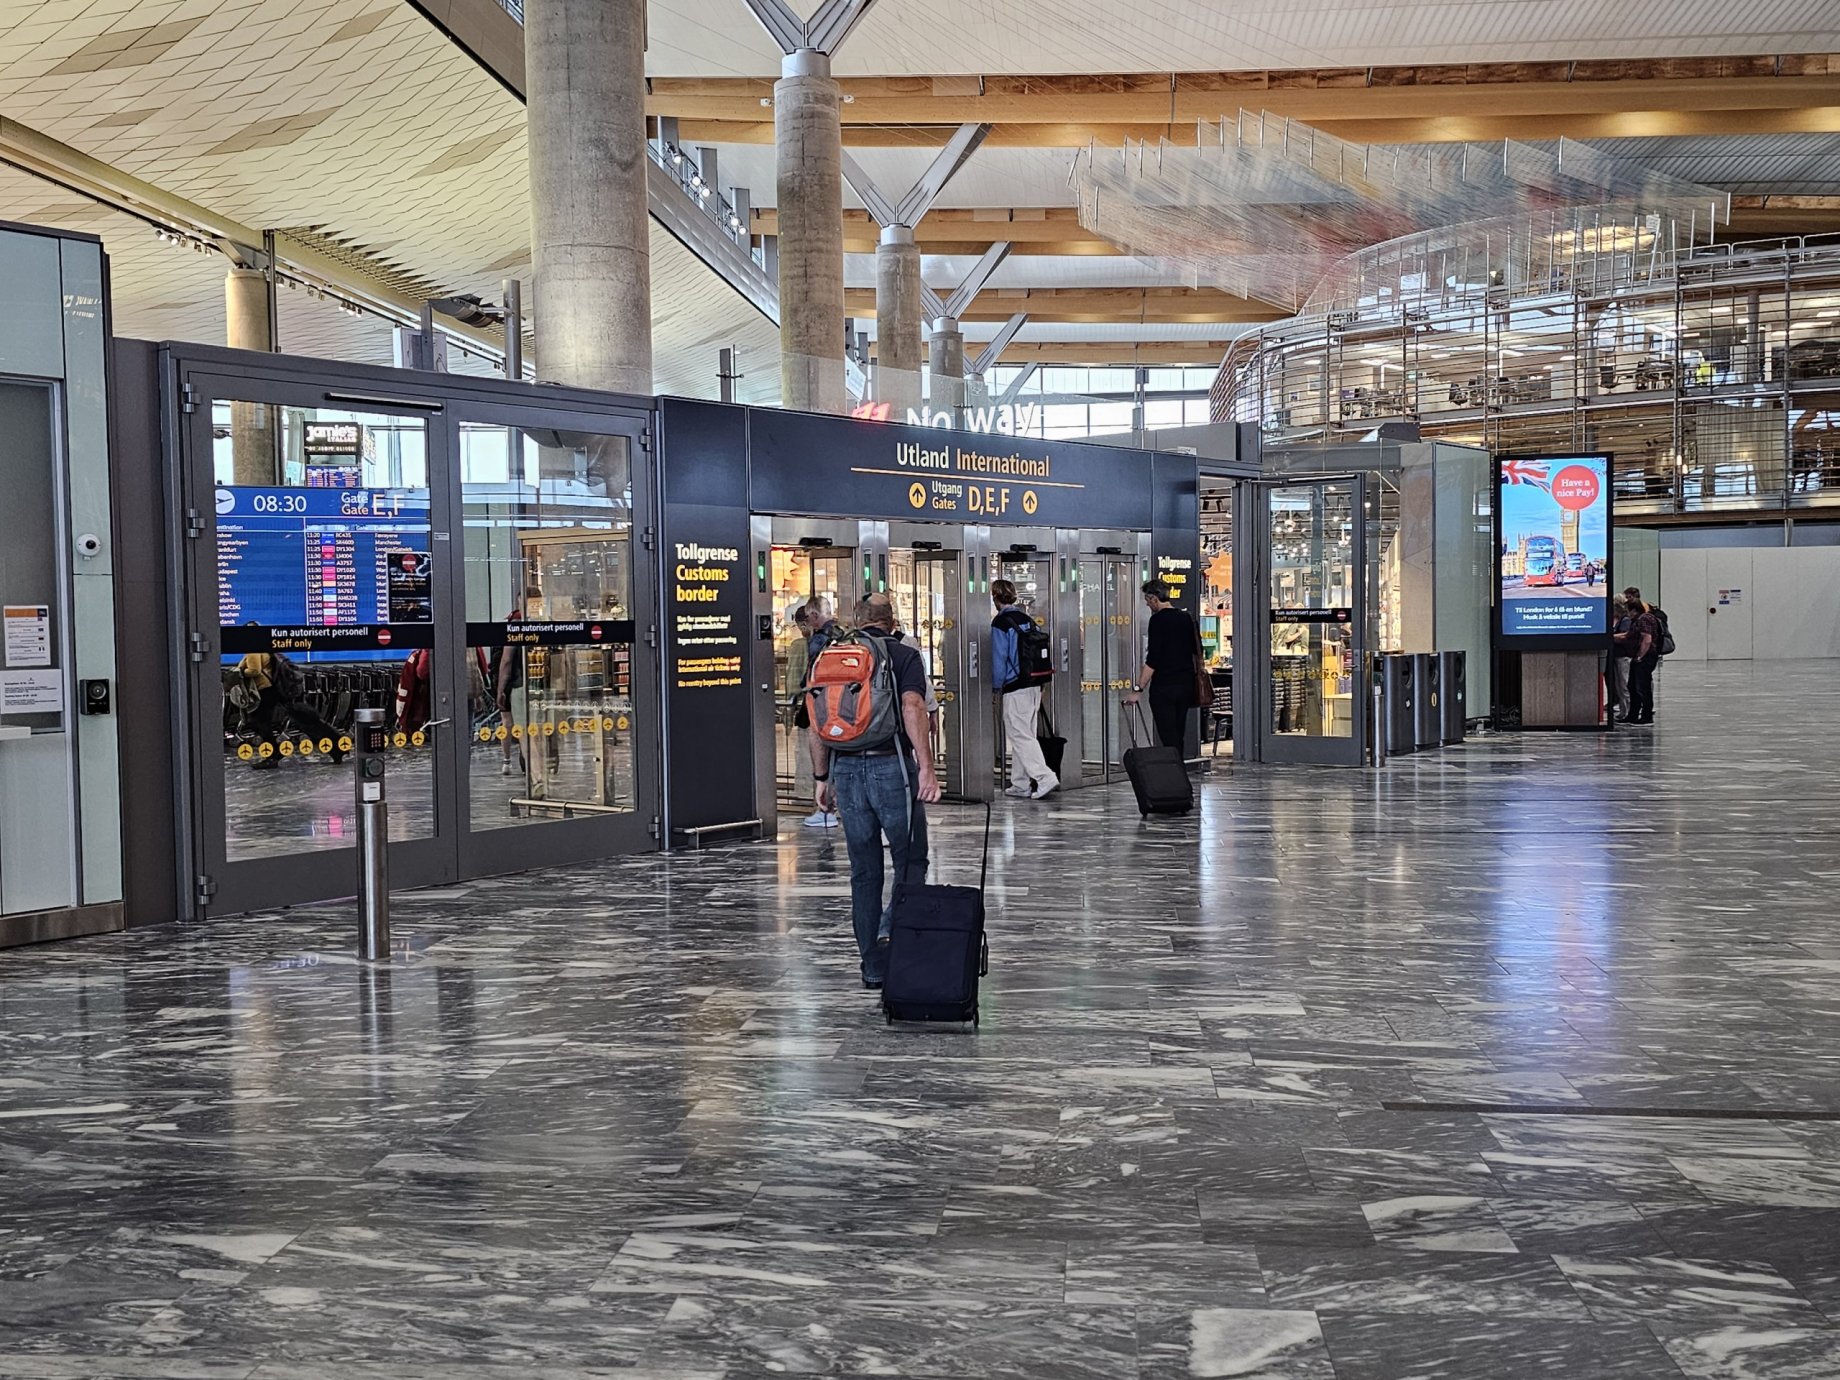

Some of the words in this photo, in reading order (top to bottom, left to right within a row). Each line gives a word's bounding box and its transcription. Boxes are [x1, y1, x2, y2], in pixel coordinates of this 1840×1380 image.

[896, 442, 950, 469] Utland
[955, 448, 1050, 477] International
[931, 480, 963, 498] Utgang
[1561, 479, 1583, 487] Have
[341, 492, 369, 504] Gate
[1556, 489, 1574, 497] nice
[1576, 488, 1595, 498] Pay!
[253, 495, 307, 512] 08:30
[372, 494, 405, 519] E,F
[931, 496, 957, 510] Gates
[968, 485, 1010, 516] D,E,F
[341, 504, 369, 515] Gate
[675, 542, 739, 564] Tollgrense
[1158, 556, 1192, 571] Tollgrense
[676, 564, 729, 582] Customs
[676, 584, 719, 602] border
[271, 628, 288, 637] Kun
[289, 627, 330, 637] autorisert
[332, 626, 369, 638] personell
[507, 624, 520, 633] Kun
[521, 622, 553, 632] autorisert
[554, 622, 584, 633] personell
[271, 639, 292, 648] Staff
[294, 639, 312, 650] only
[507, 634, 524, 642] Staff
[524, 634, 540, 643] only
